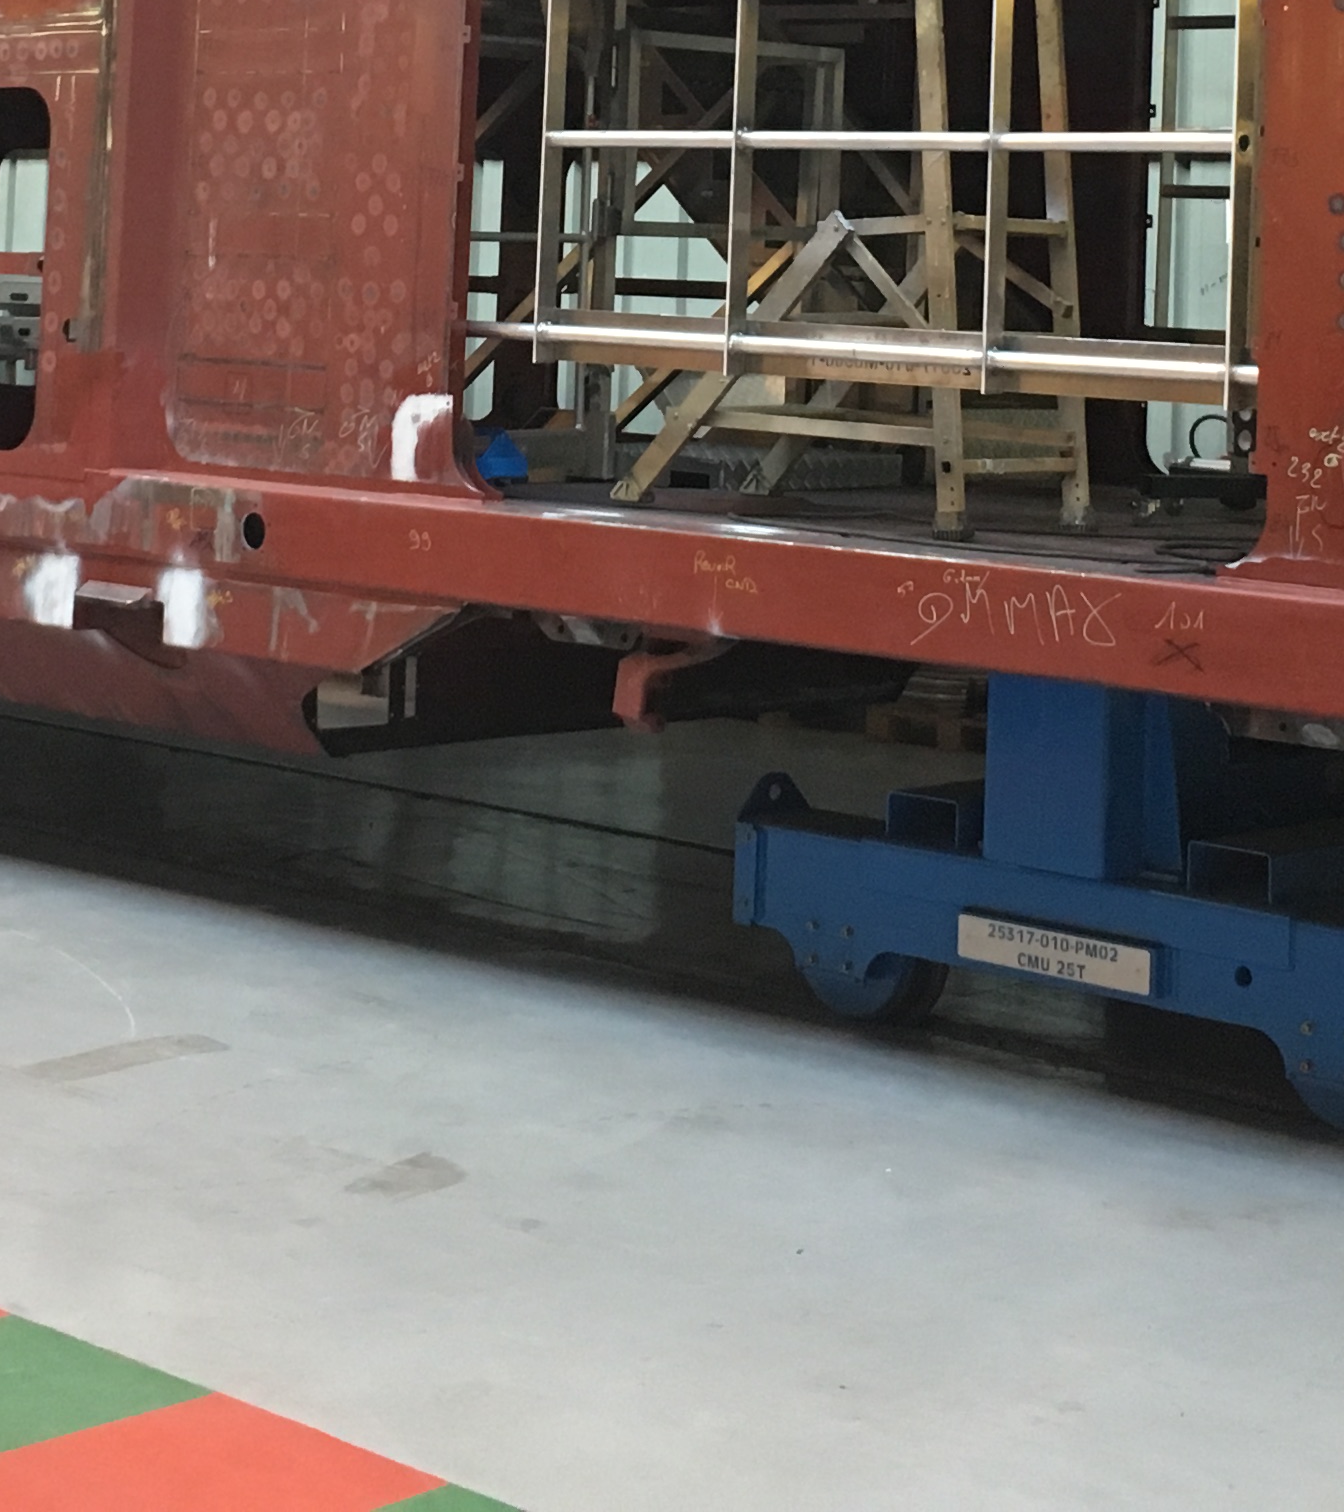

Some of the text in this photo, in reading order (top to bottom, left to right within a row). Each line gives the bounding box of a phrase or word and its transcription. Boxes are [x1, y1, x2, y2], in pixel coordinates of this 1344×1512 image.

[987, 922, 1120, 963] 25317-010-PM02
[1017, 951, 1087, 979] CMU 25T
